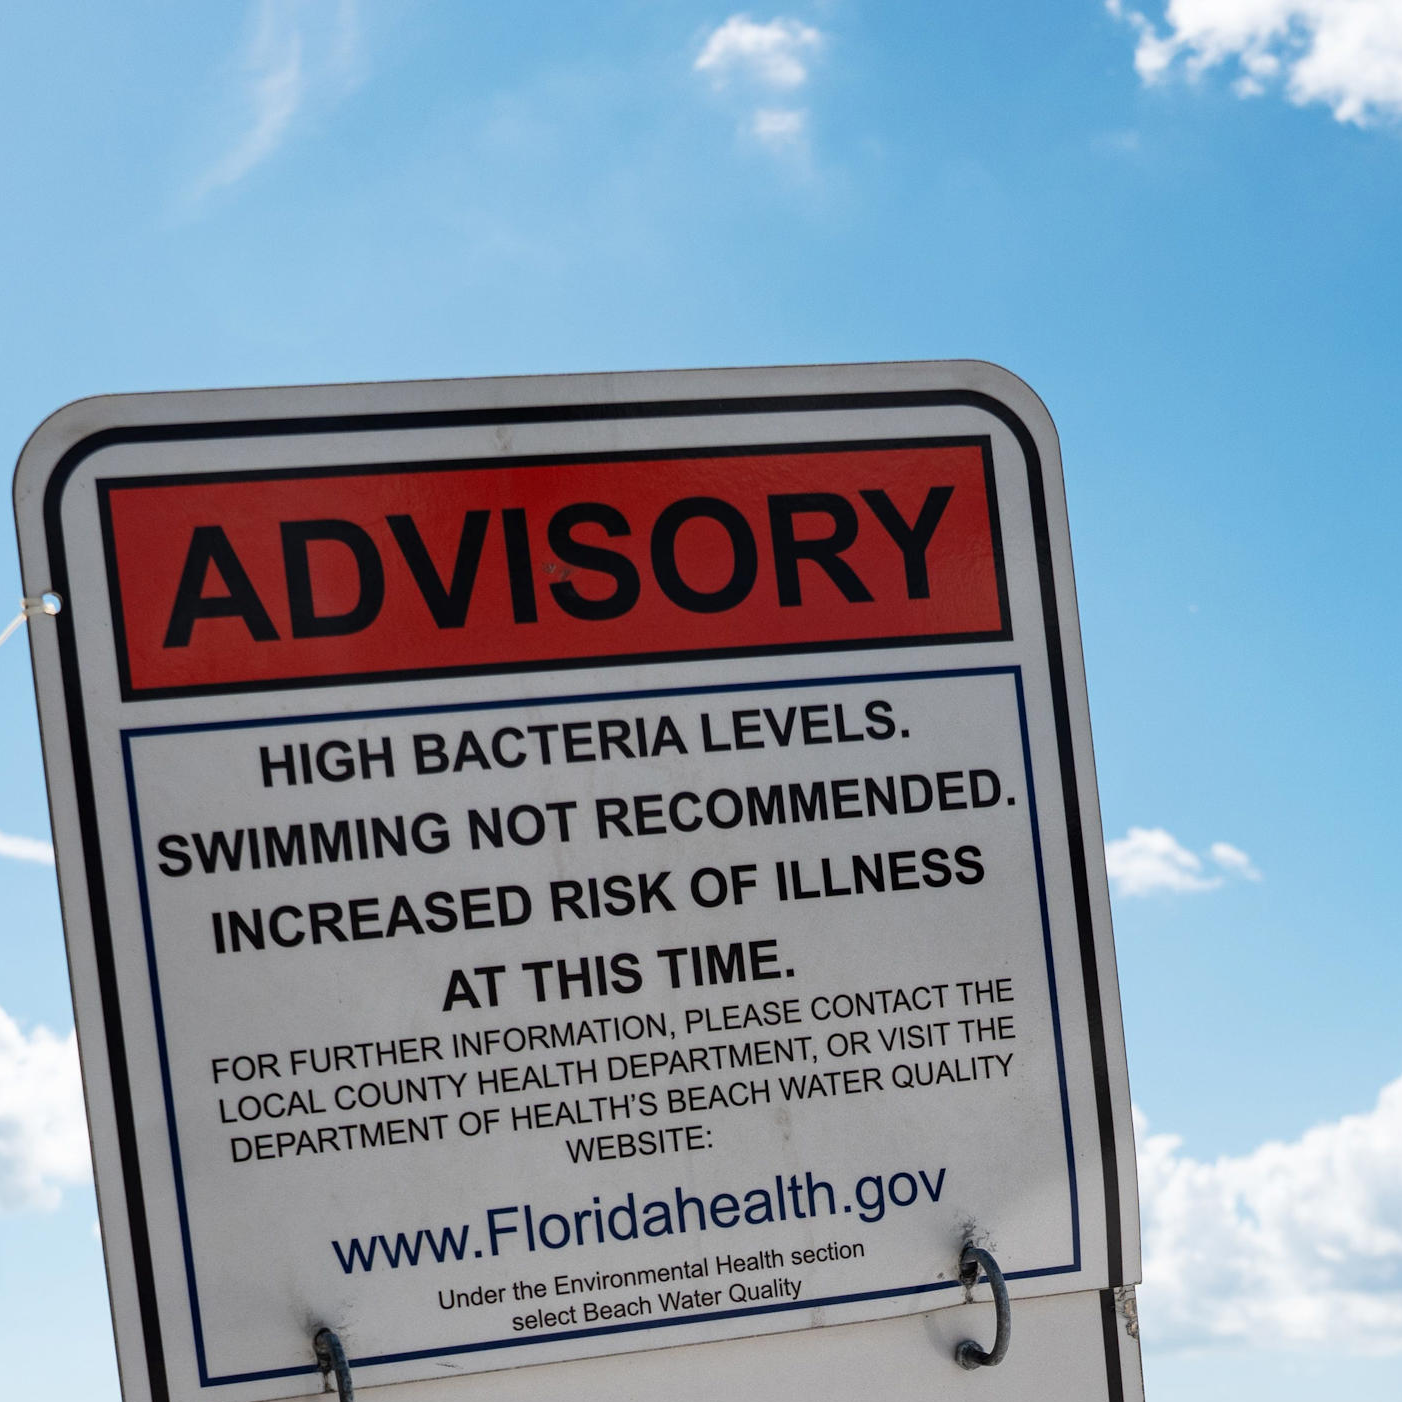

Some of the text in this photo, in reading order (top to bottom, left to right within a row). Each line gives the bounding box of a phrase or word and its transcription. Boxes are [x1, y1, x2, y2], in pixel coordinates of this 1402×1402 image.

[161, 484, 956, 650] ADVISORY
[258, 699, 910, 788] HIGH BACTERIA LEVELS.
[156, 768, 1016, 878] SWIMMING NOT RECOMMENDED.
[211, 844, 985, 955] INCREASED RISK OF ILLNESS
[441, 938, 795, 1013] AT THIS TIME.
[211, 977, 1015, 1085] FOR FURTHER INFORMATION, PLEASE CONTACT THE
[218, 1015, 1017, 1124] LOCAL COUNTY HEALTH DEPARTMENT, OR VISIT THE
[230, 1113, 449, 1164] DEPARTMENT
[458, 1108, 501, 1137] OF
[666, 1079, 771, 1114] BEACH
[777, 1067, 885, 1102] WATER
[891, 1052, 1014, 1089] QUALITY
[565, 1124, 713, 1164] WEBSITE:
[330, 1167, 947, 1275] www.Floridahealth.gov
[438, 1242, 865, 1310] Under the Environmental Health section
[512, 1277, 802, 1332] select Beach Water Quality
